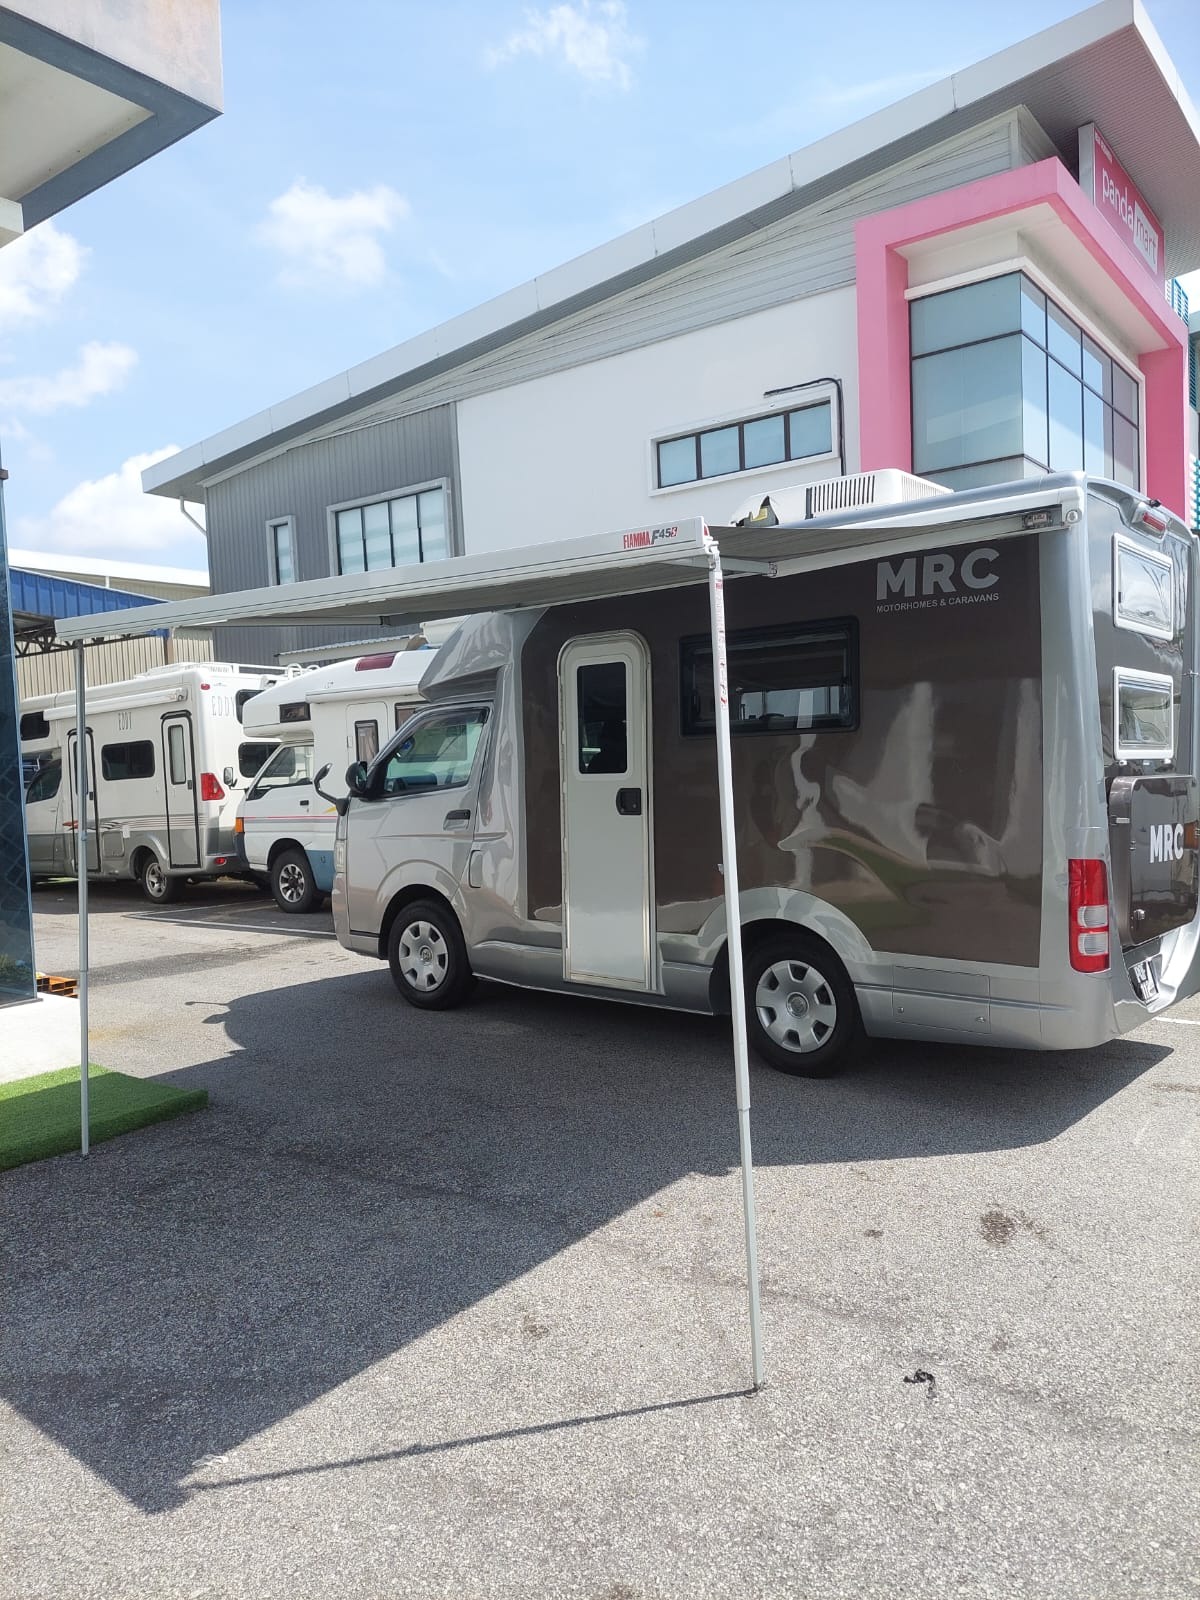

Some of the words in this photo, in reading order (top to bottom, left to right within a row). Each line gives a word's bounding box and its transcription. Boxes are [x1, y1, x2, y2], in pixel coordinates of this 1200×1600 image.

[623, 531, 651, 549] FIAMMA
[876, 547, 1000, 600] MRC
[876, 599, 938, 614] MOTORHOMES
[939, 598, 947, 607] &
[948, 592, 1000, 606] CARAVANS
[1149, 823, 1184, 864] MRC
